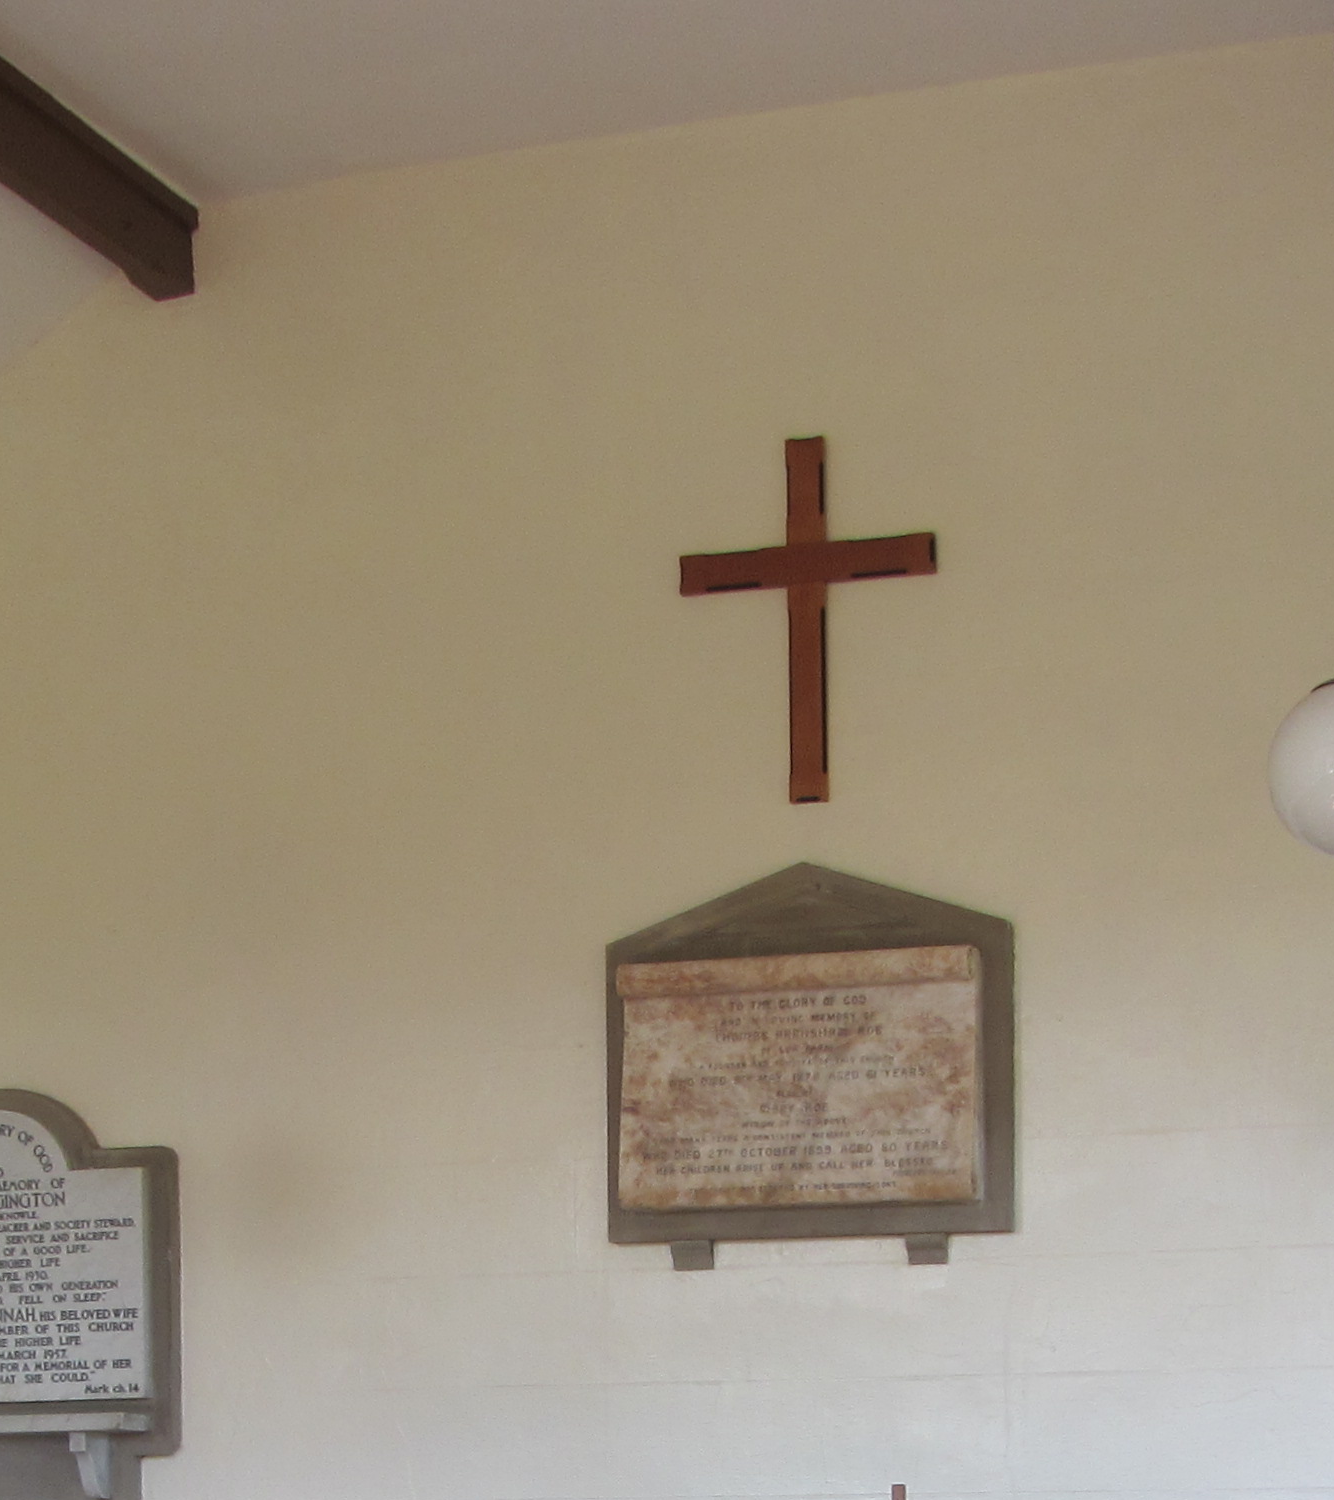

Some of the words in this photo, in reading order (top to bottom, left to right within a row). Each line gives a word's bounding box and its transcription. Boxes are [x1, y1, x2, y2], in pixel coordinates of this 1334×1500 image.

[778, 998, 816, 1010] GLORY
[823, 996, 835, 1006] OF
[843, 994, 867, 1006] GOD
[811, 1012, 857, 1022] MEMORY
[883, 1065, 926, 1078] YEARS
[18, 1130, 34, 1146] OF
[33, 1144, 53, 1173] GOD
[740, 1146, 797, 1158] OCTOBER
[840, 1142, 874, 1154] AGED
[905, 1139, 948, 1151] YEARS
[680, 1164, 731, 1175] CHILDREN
[790, 1161, 813, 1171] AND
[818, 1160, 845, 1170] CALL
[50, 1177, 65, 1189] OF
[33, 1220, 52, 1231] AND
[54, 1219, 91, 1230] SOCIETY
[6, 1233, 45, 1245] SERVICE
[50, 1232, 70, 1242] AND
[74, 1230, 119, 1242] SACRIFICE
[3, 1246, 16, 1257] OF
[21, 1247, 28, 1256] A
[33, 1245, 62, 1255] GOOD
[40, 1257, 61, 1268] LIFE
[9, 1282, 24, 1293] HIS
[29, 1281, 53, 1292] OWN
[61, 1279, 119, 1291] GENERATION
[19, 1294, 44, 1306] FELL
[52, 1293, 67, 1303] ON
[39, 1310, 56, 1321] HIS
[60, 1309, 110, 1320] BELOVED
[112, 1307, 138, 1318] WIFE
[35, 1323, 50, 1334] OF
[56, 1322, 80, 1333] THIS
[88, 1321, 134, 1332] CHURCH
[14, 1336, 53, 1348] HIGHER
[59, 1335, 81, 1346] LIFE
[0, 1362, 19, 1373] FOR
[21, 1362, 30, 1372] A
[34, 1360, 90, 1372] MEMORIAL
[93, 1359, 108, 1370] OF
[112, 1358, 132, 1369] HER
[24, 1373, 43, 1384] SHE
[128, 1382, 140, 1393] 14
